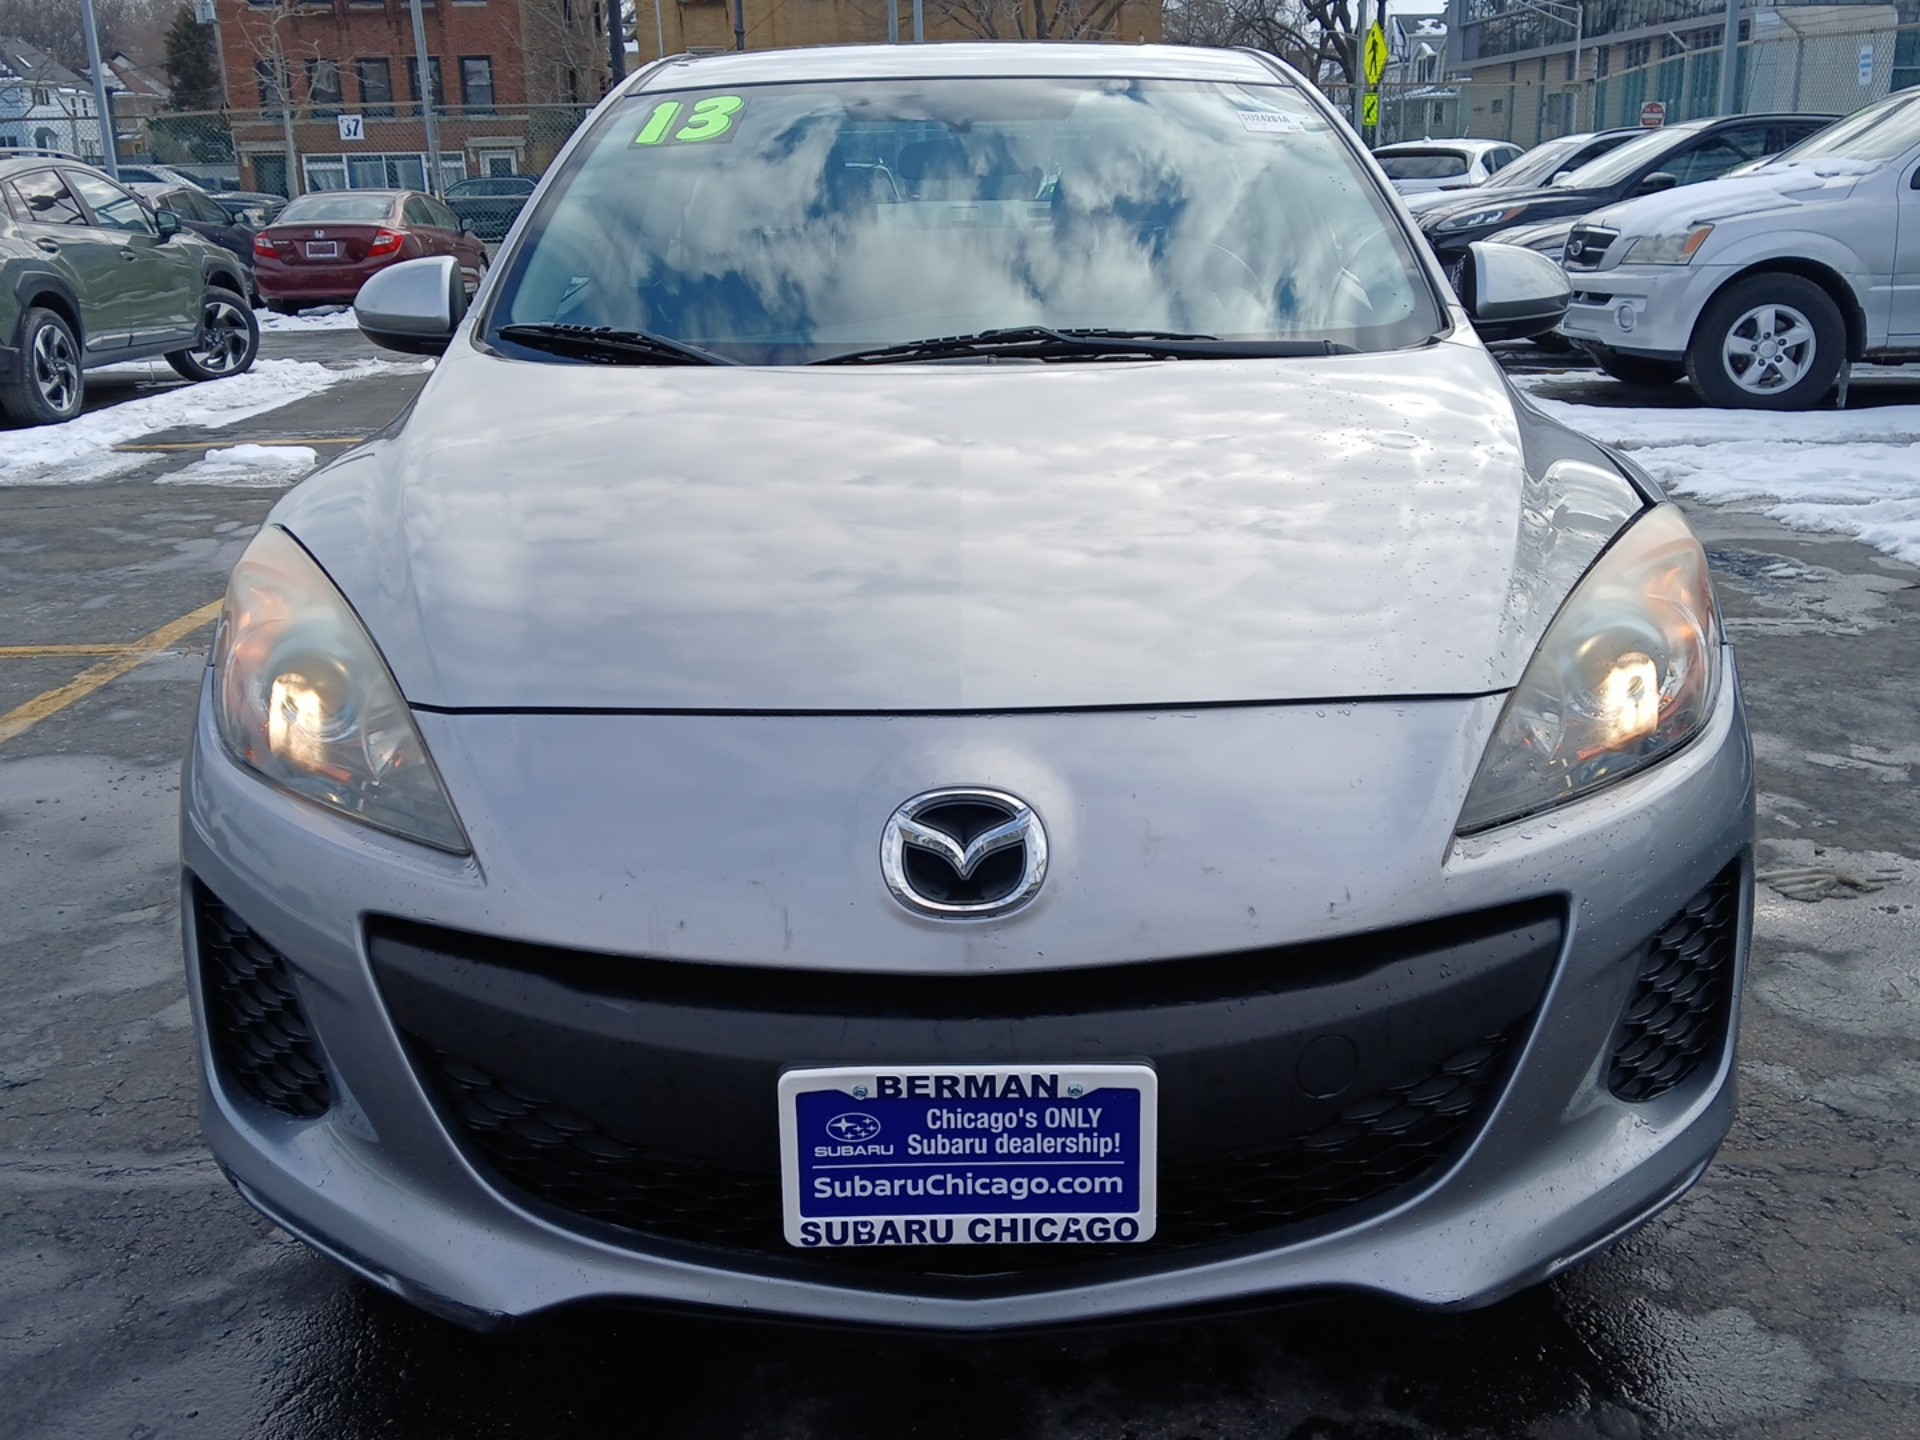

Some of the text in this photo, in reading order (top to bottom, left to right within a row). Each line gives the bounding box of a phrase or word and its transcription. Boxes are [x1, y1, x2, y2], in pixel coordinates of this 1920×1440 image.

[635, 95, 745, 145] 13
[875, 1073, 1059, 1099] BERMAN
[926, 1107, 1103, 1132] Chicago's ONLY
[814, 1144, 895, 1157] SUBARU
[907, 1133, 1121, 1158] Subaru dealership!
[813, 1173, 1124, 1200] SubaruChicago.com
[799, 1217, 1140, 1246] SUBARU CHICAGO
